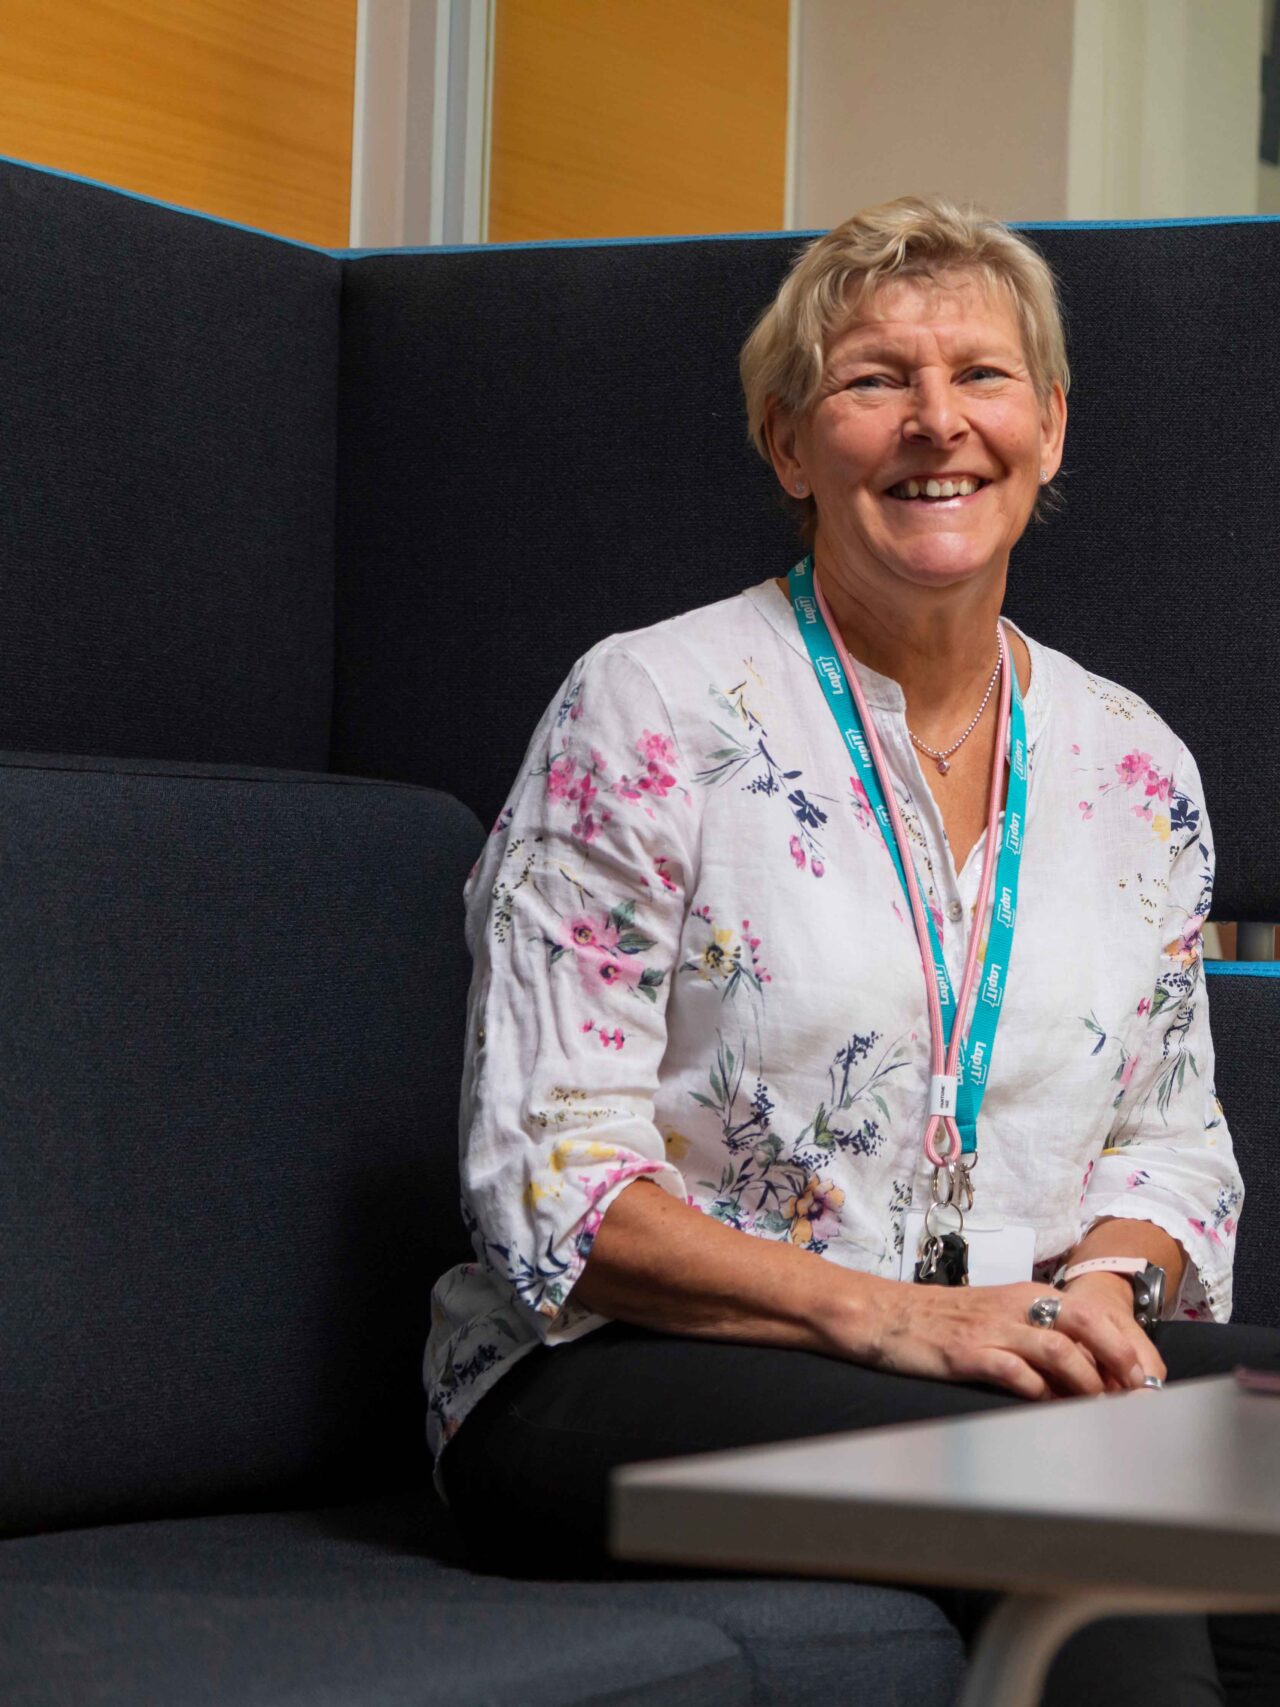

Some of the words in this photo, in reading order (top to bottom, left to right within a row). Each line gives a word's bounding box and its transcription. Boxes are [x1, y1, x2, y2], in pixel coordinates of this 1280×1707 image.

[799, 599, 817, 625] LapIT
[821, 660, 844, 695] LapIT
[1014, 738, 1024, 776] LapIT
[1010, 812, 1021, 850] LapIT
[1000, 886, 1012, 923] LapIT
[986, 963, 1002, 1002] LapIT
[970, 1041, 987, 1080] LapIT
